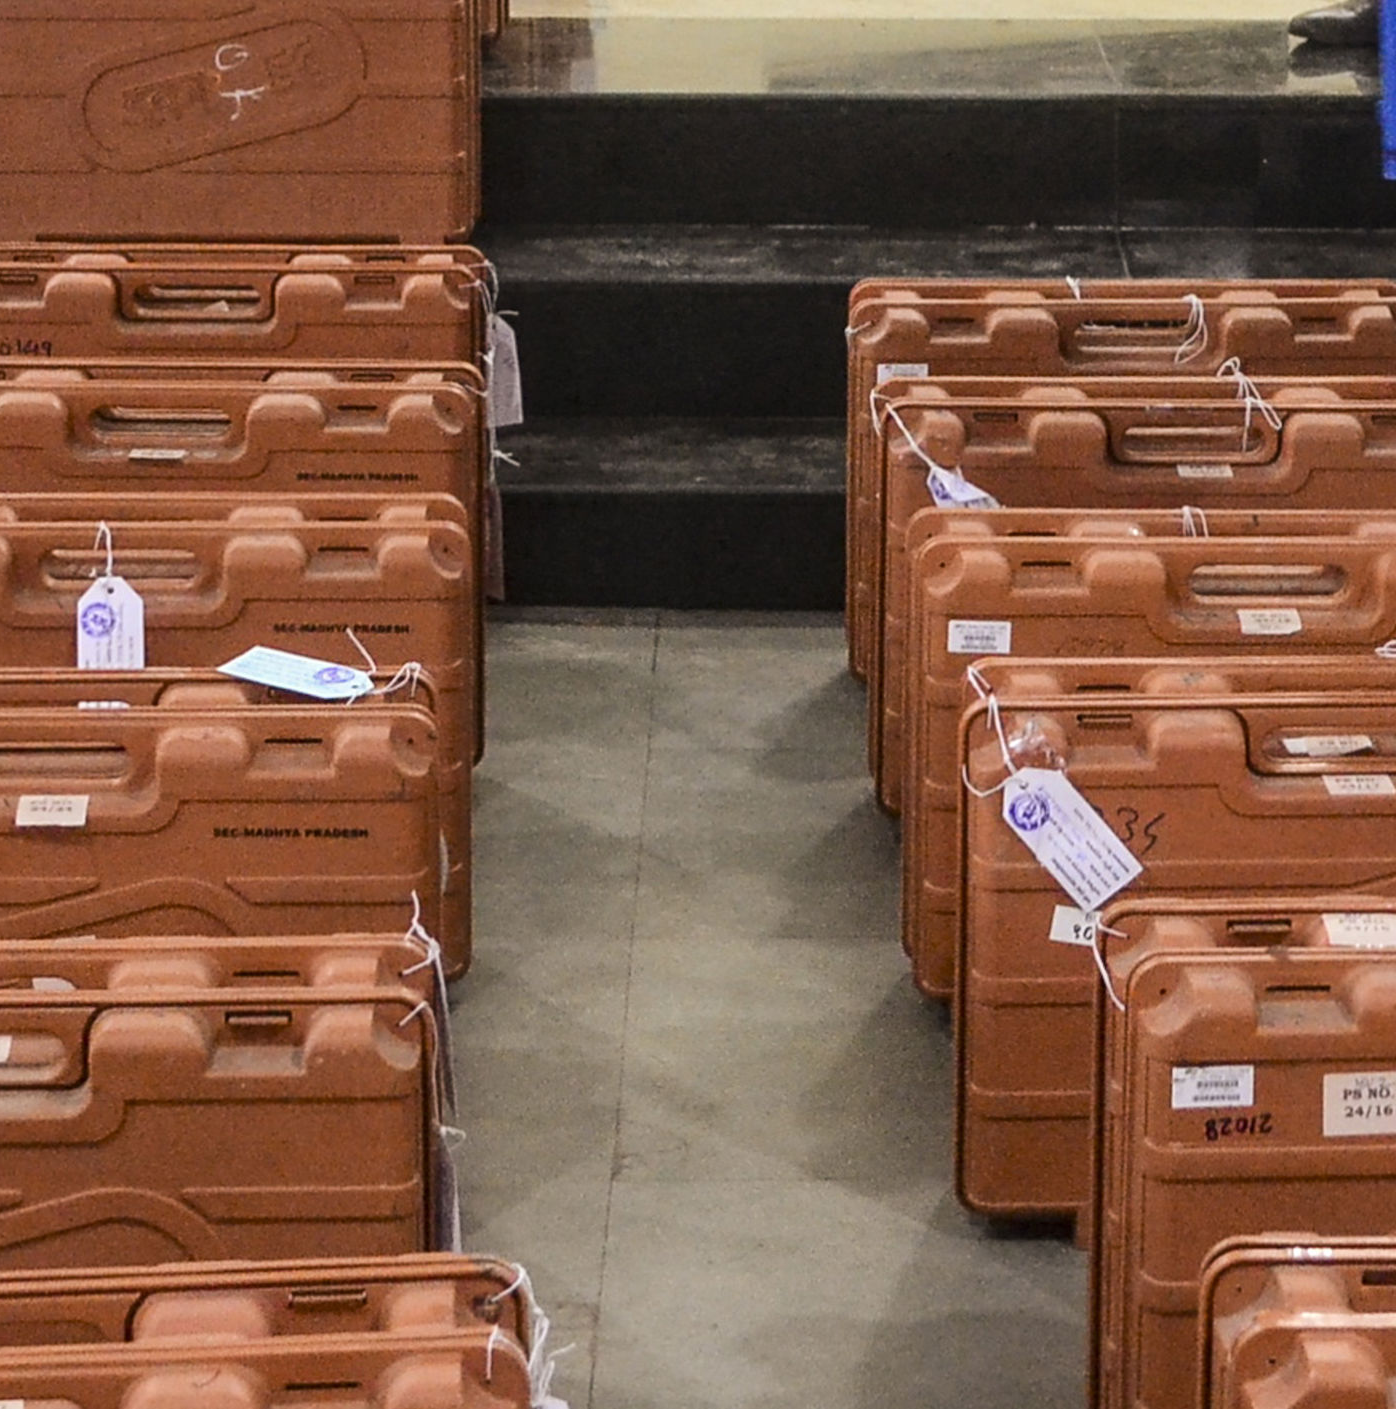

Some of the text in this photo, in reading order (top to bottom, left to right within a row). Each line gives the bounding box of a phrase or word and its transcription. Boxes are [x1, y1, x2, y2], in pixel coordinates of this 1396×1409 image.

[305, 827, 369, 838] PRADESH
[1342, 1087, 1395, 1100] PS NO.
[1344, 1105, 1394, 1118] 24/16
